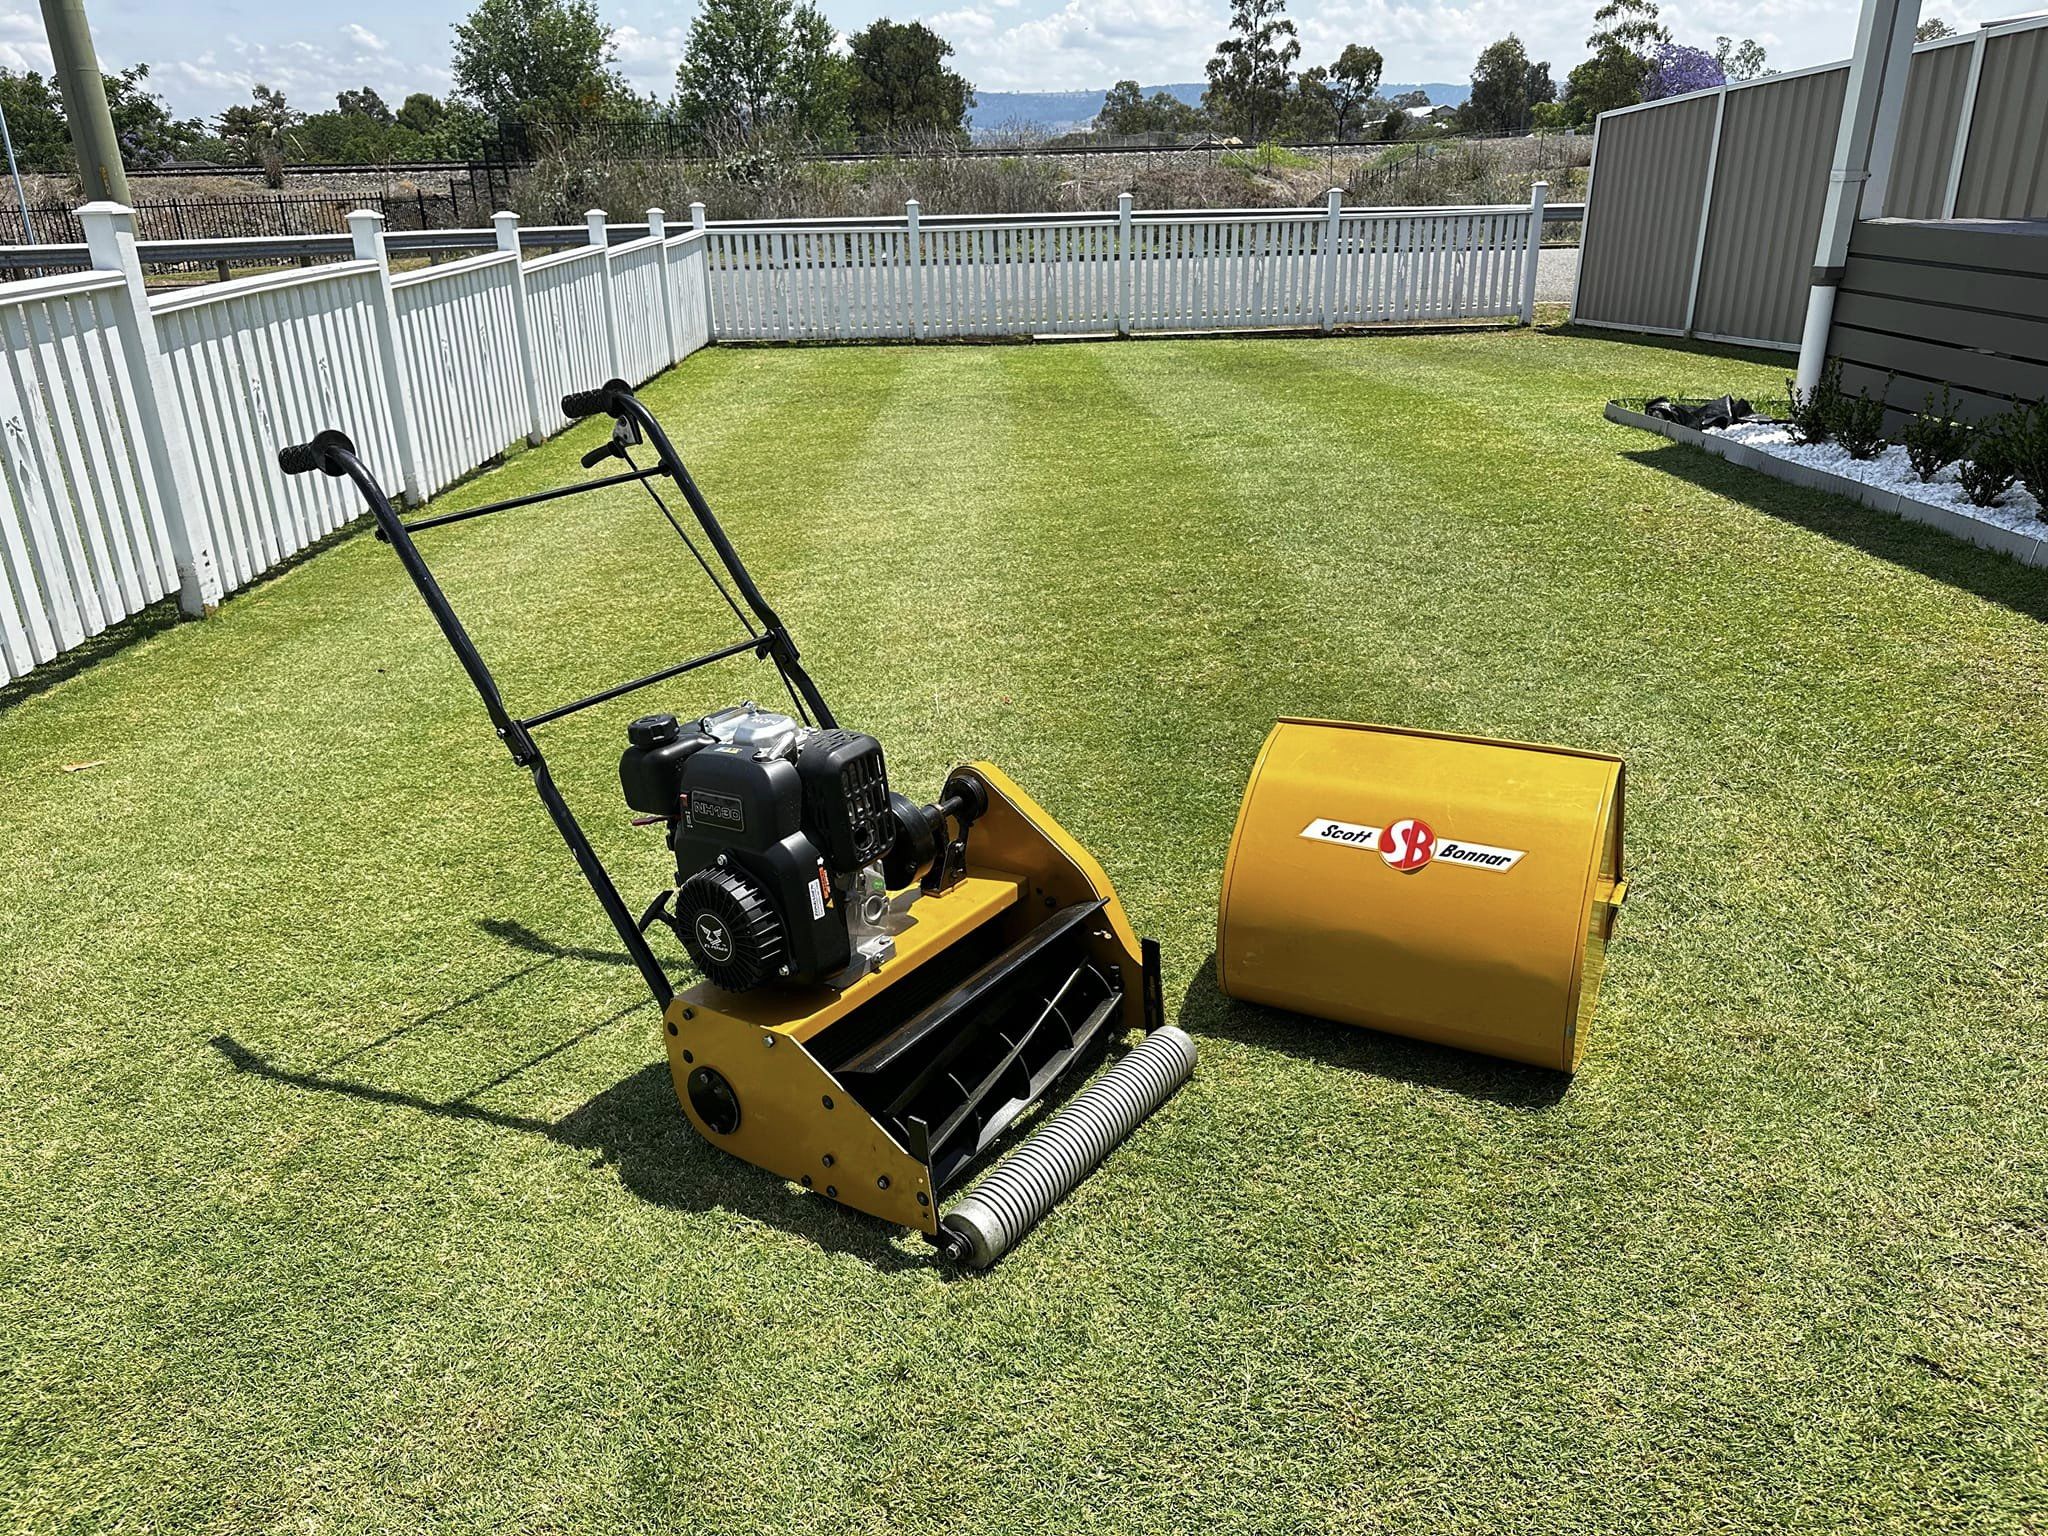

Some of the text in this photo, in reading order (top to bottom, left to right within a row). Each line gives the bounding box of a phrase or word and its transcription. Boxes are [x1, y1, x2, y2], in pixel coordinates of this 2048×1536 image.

[693, 801, 741, 821] NH130
[1321, 819, 1511, 869] Scott SB Bonnar
